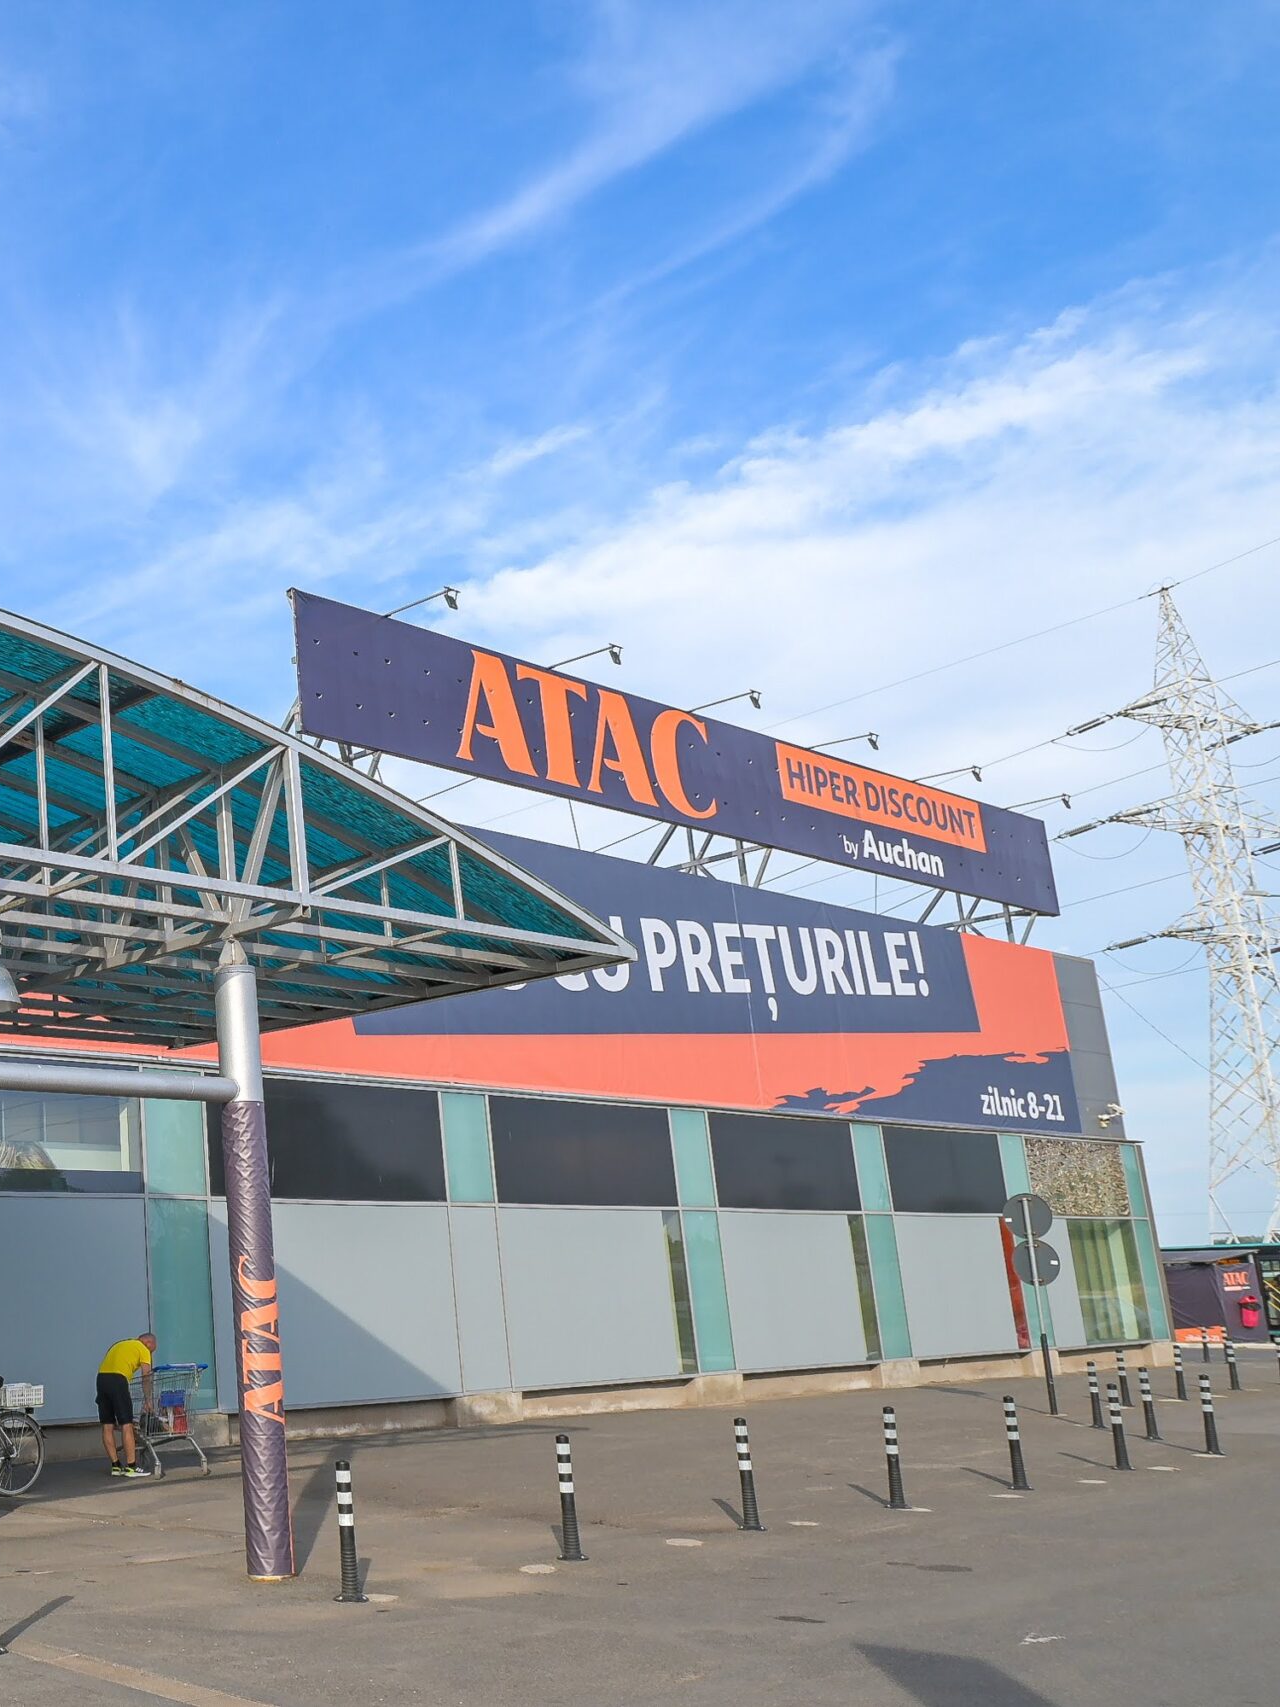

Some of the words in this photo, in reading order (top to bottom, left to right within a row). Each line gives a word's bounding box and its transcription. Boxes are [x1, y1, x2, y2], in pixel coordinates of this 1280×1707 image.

[455, 649, 717, 820] ATAC
[786, 757, 860, 808] HIPER
[863, 781, 975, 839] DISCOUNT
[843, 835, 858, 860] by
[863, 829, 945, 877] Auchan
[640, 917, 930, 1022] PREȚURILE!
[980, 1085, 1027, 1119] zilnic
[1027, 1091, 1065, 1121] 8-21
